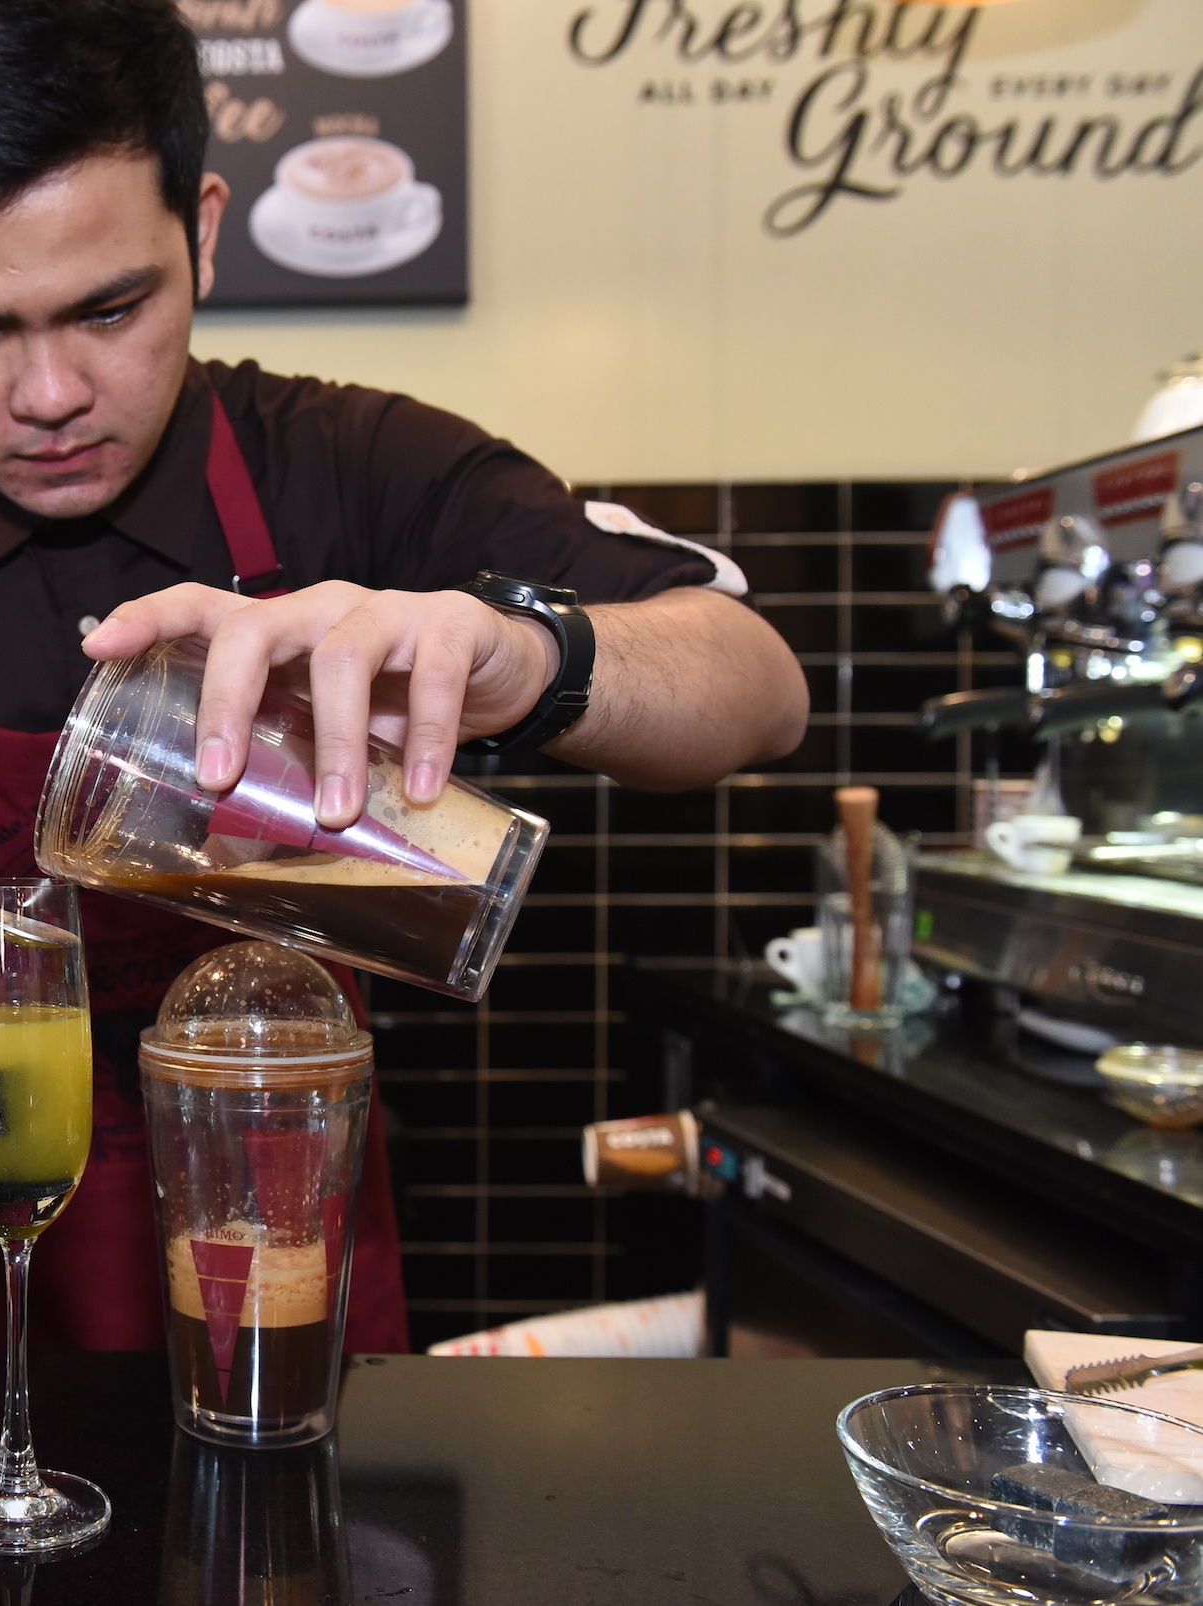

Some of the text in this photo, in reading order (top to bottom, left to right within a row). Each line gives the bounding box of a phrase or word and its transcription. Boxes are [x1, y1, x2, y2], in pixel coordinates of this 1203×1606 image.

[638, 75, 776, 105] ALL DAY
[989, 71, 1172, 98] EVERY DAY
[200, 1228, 245, 1241] RIMO
